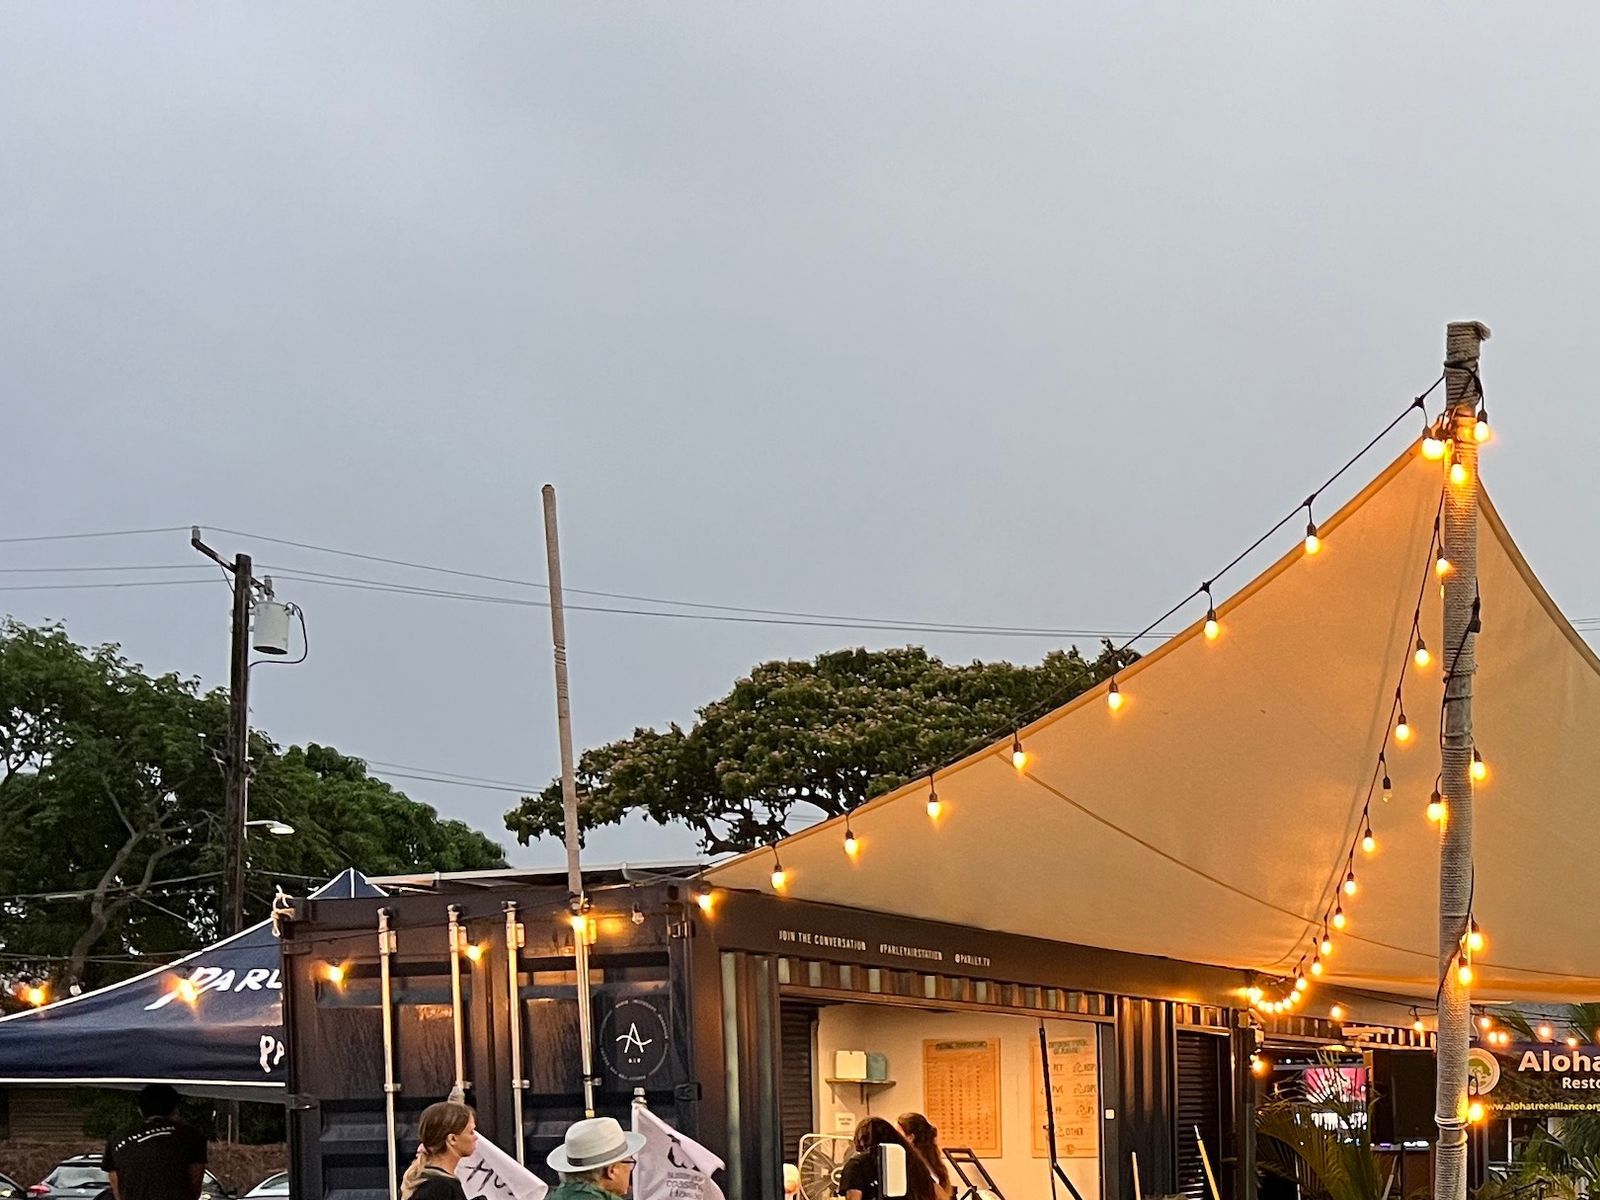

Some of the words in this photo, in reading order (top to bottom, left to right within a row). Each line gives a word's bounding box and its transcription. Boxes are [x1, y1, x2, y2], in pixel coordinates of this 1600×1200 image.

[778, 930, 795, 942] JOIN
[798, 932, 811, 944] THE
[814, 934, 866, 950] CONVERSATION
